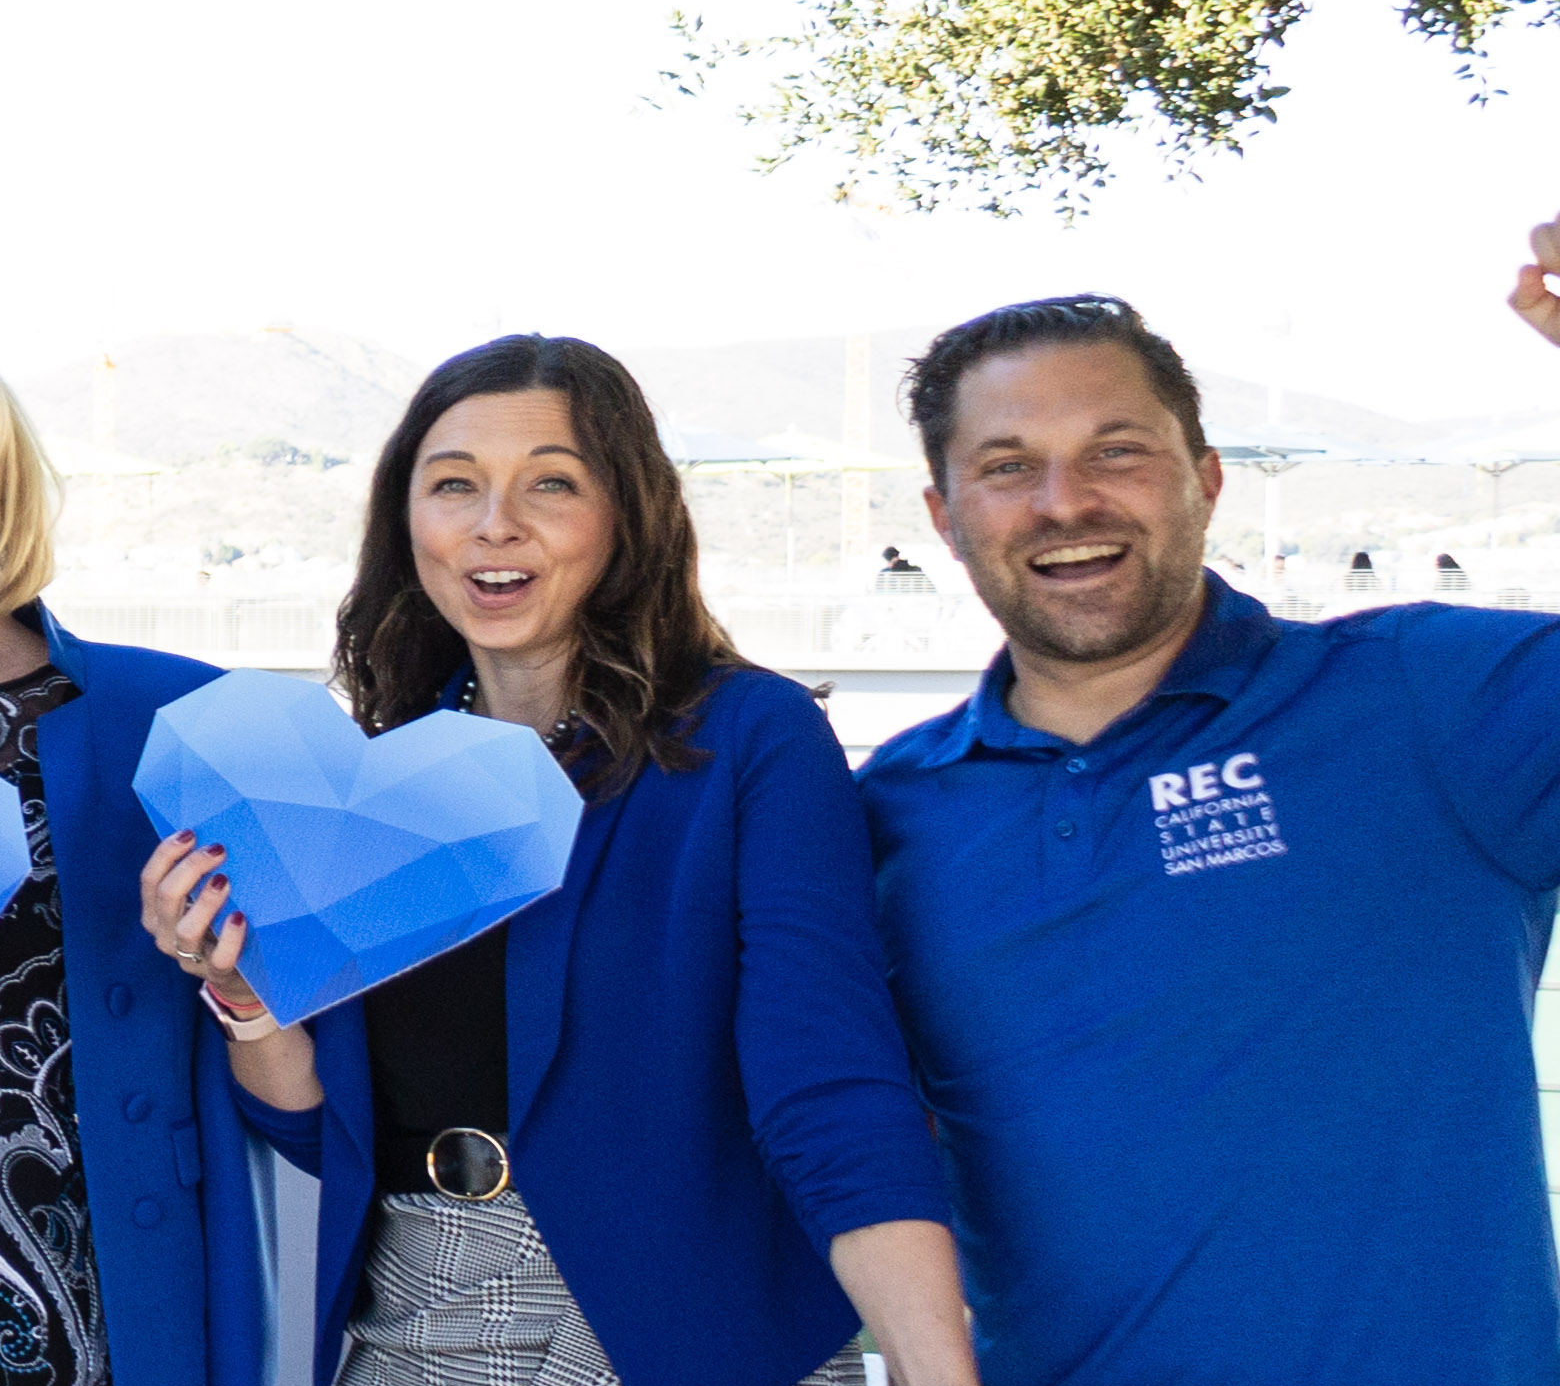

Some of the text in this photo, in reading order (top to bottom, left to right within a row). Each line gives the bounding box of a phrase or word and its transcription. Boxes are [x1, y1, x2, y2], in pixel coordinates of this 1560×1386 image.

[1148, 752, 1265, 812] REC
[1154, 791, 1271, 829] CALIFORNIA
[1161, 823, 1280, 860] UNIVERSITY
[1163, 839, 1288, 876] SAN MARCOS
